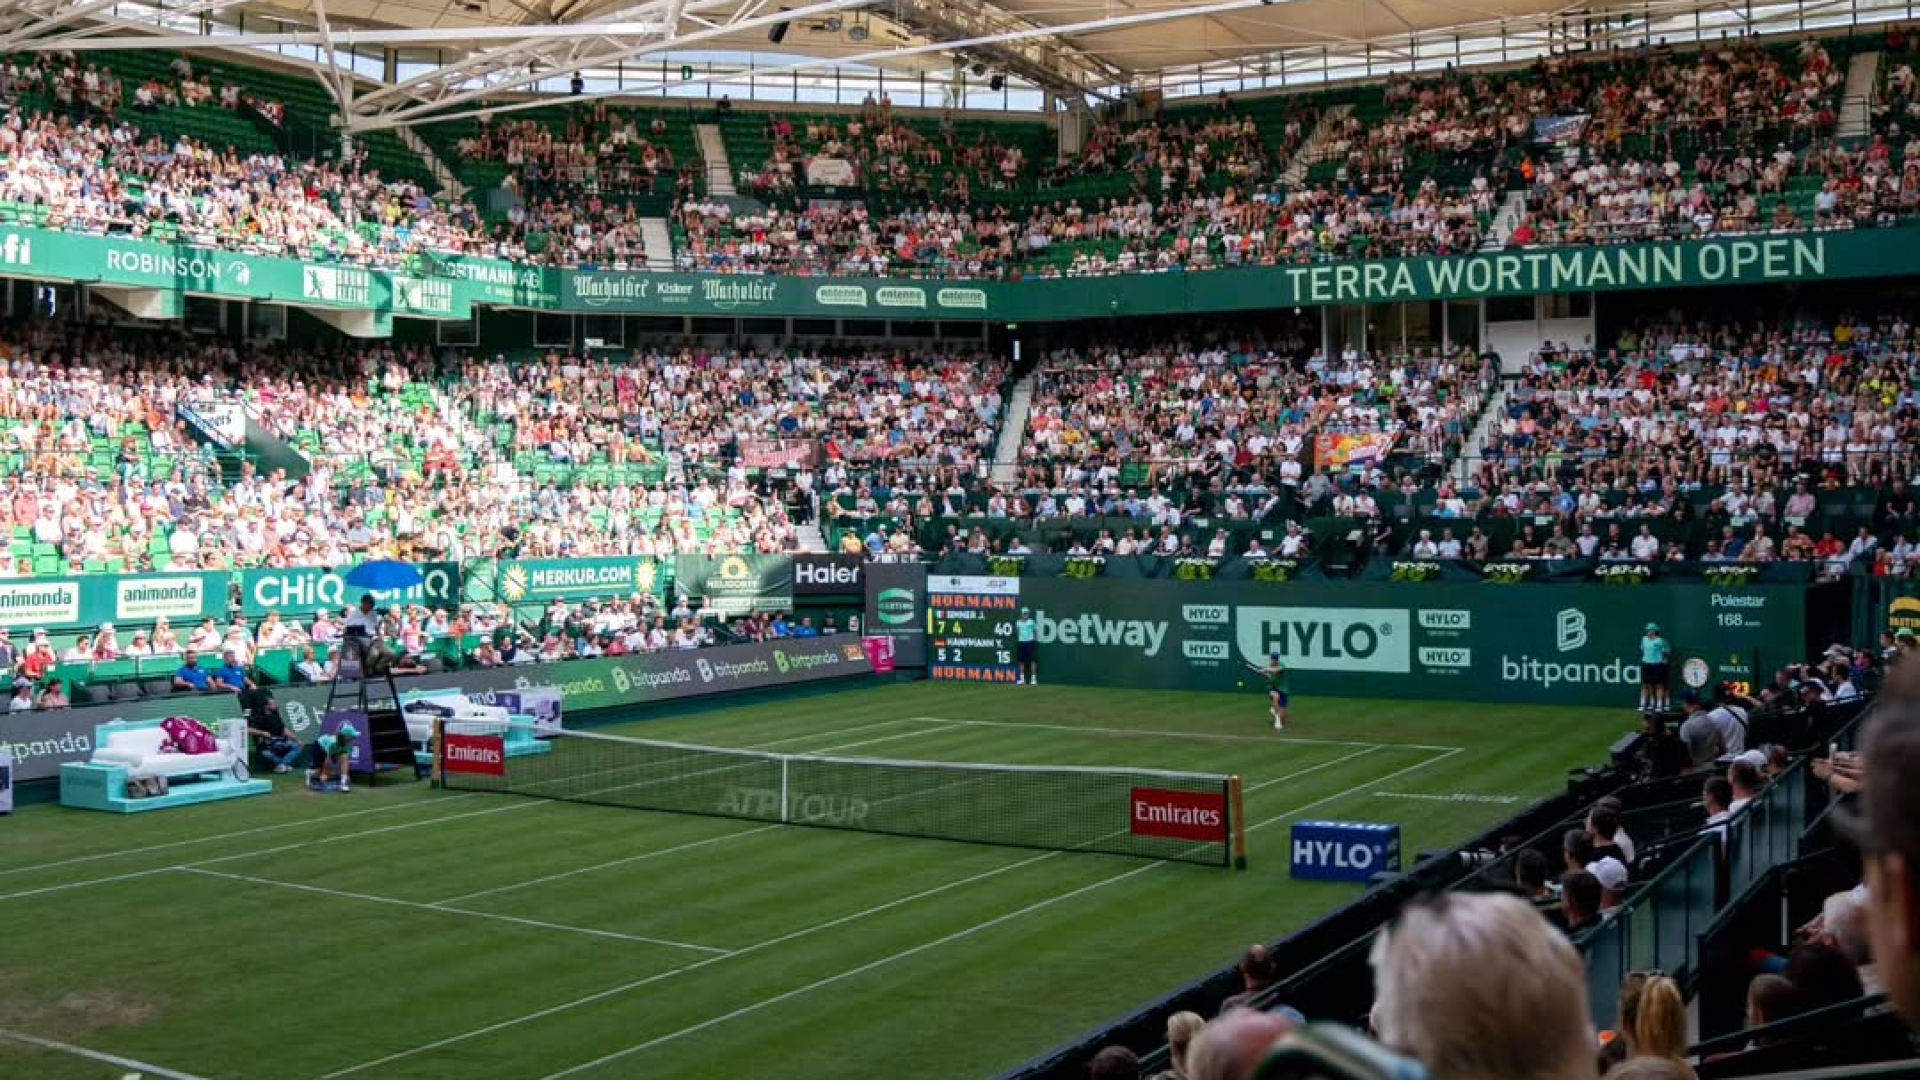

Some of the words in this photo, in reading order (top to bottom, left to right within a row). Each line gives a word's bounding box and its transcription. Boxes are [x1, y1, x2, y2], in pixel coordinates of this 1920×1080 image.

[107, 248, 221, 279] ROBINSON
[1286, 261, 1417, 302] TERRA
[1427, 246, 1682, 294] WORTMANN
[1698, 237, 1825, 280] OPEN
[532, 566, 631, 585] MERKUR.COM
[795, 562, 860, 584] Haier
[123, 582, 197, 602] animonda
[254, 573, 344, 606] CHiQ
[1711, 592, 1766, 607] Polestar
[937, 621, 945, 633] 7
[952, 621, 962, 633] 4
[994, 622, 1013, 636] 40
[1717, 613, 1743, 627] 168
[1035, 610, 1169, 656] betway
[715, 656, 769, 678] bitpanda
[938, 648, 946, 661] 5
[952, 649, 962, 661] 2
[996, 651, 1011, 664] 15
[631, 666, 691, 690] bitpanda
[1502, 654, 1642, 688] bitpanda
[447, 743, 501, 763] Emirates
[1134, 800, 1221, 826] Emirates
